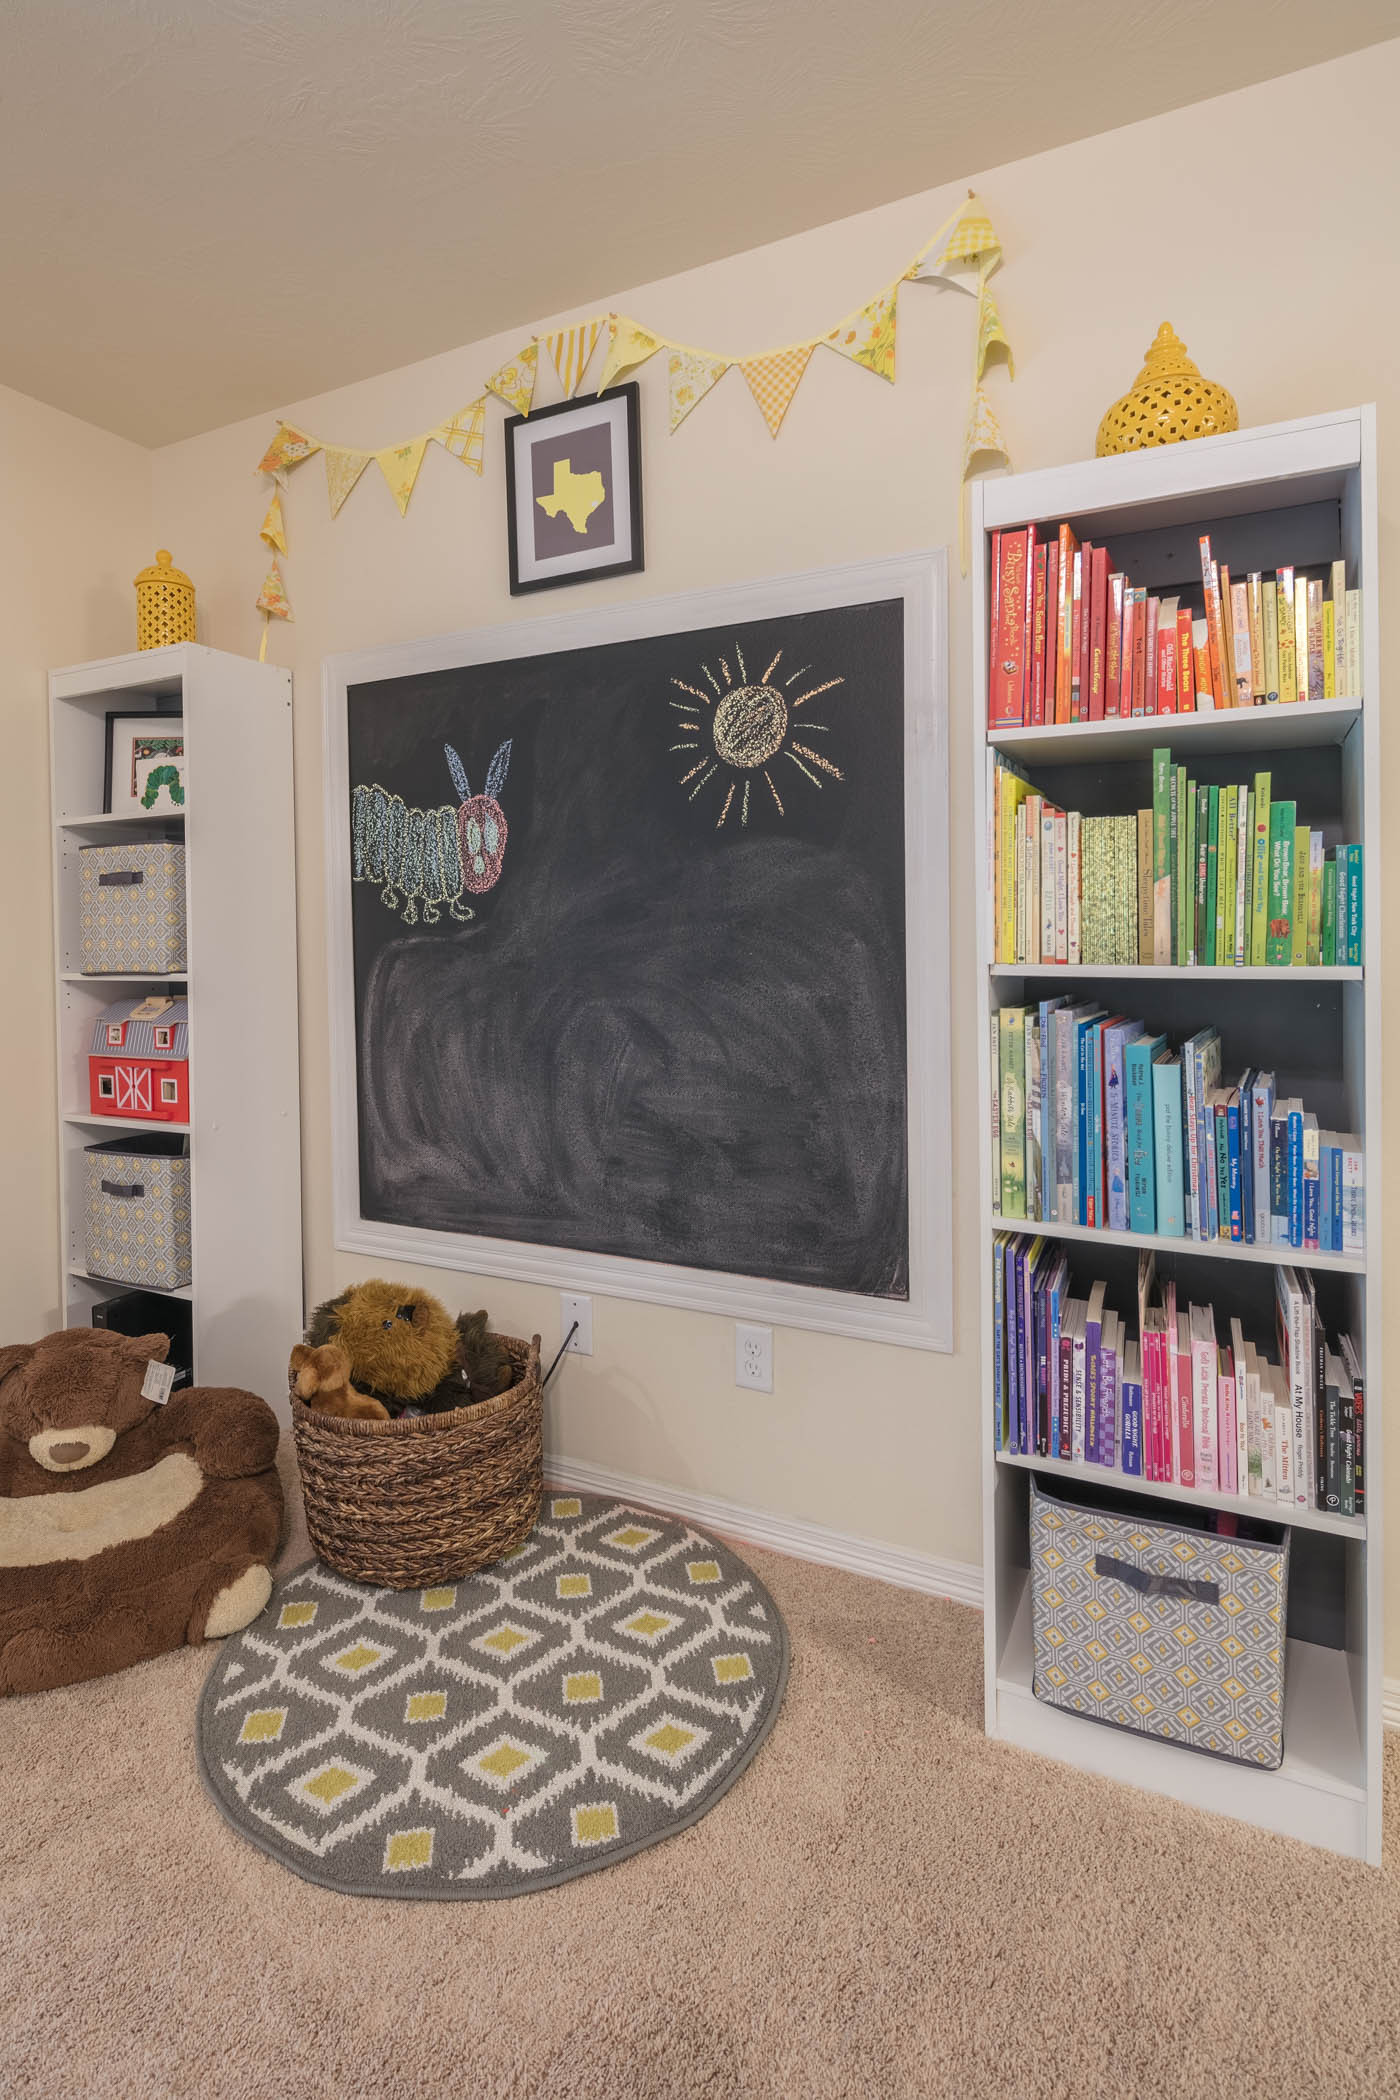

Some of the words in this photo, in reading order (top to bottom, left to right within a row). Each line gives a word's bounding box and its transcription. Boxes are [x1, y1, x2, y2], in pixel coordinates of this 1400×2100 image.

[1002, 552, 1023, 585] Busy
[1003, 585, 1020, 625] Santa
[1035, 610, 1044, 633] Santa
[1181, 632, 1189, 646] The
[1166, 643, 1174, 655] Old
[1093, 648, 1101, 672] Curious
[1182, 648, 1190, 669] Three
[1092, 673, 1101, 695] George
[1228, 798, 1237, 809] All
[1228, 813, 1236, 841] Better!
[1274, 859, 1281, 868] Do
[1282, 862, 1290, 879] Bear,
[1337, 888, 1345, 905] Night
[1143, 917, 1152, 937] Tales
[1189, 1113, 1197, 1131] Stays
[1165, 1125, 1174, 1142] bunny
[1189, 1133, 1197, 1143] Up
[1219, 1143, 1224, 1151] No
[1275, 1146, 1281, 1154] On
[1220, 1152, 1227, 1164] No
[1231, 1158, 1238, 1167] My
[1191, 1157, 1199, 1192] Christmas
[1220, 1176, 1228, 1188] Yes
[1307, 1222, 1316, 1237] Night
[1293, 1306, 1301, 1337] Lift-the-Flap
[1294, 1338, 1302, 1357] Shadow
[1102, 1353, 1112, 1373] Let's
[1200, 1351, 1209, 1364] God's
[1062, 1359, 1070, 1381] PRIDE
[1201, 1366, 1209, 1381] Little
[1294, 1360, 1302, 1375] Book
[1102, 1375, 1112, 1385] Be
[1201, 1383, 1209, 1405] Princess
[1295, 1384, 1303, 1394] At
[1102, 1388, 1112, 1417] Friends
[1293, 1396, 1303, 1409] My
[1181, 1396, 1190, 1429] Cinderella
[1201, 1407, 1210, 1433] Devotional
[1124, 1413, 1132, 1440] GORILLA
[1295, 1410, 1304, 1438] House
[1201, 1436, 1210, 1449] Bible
[1344, 1443, 1352, 1459] Night
[1281, 1455, 1289, 1480] Mitten
[1296, 1461, 1304, 1478] Priddy
